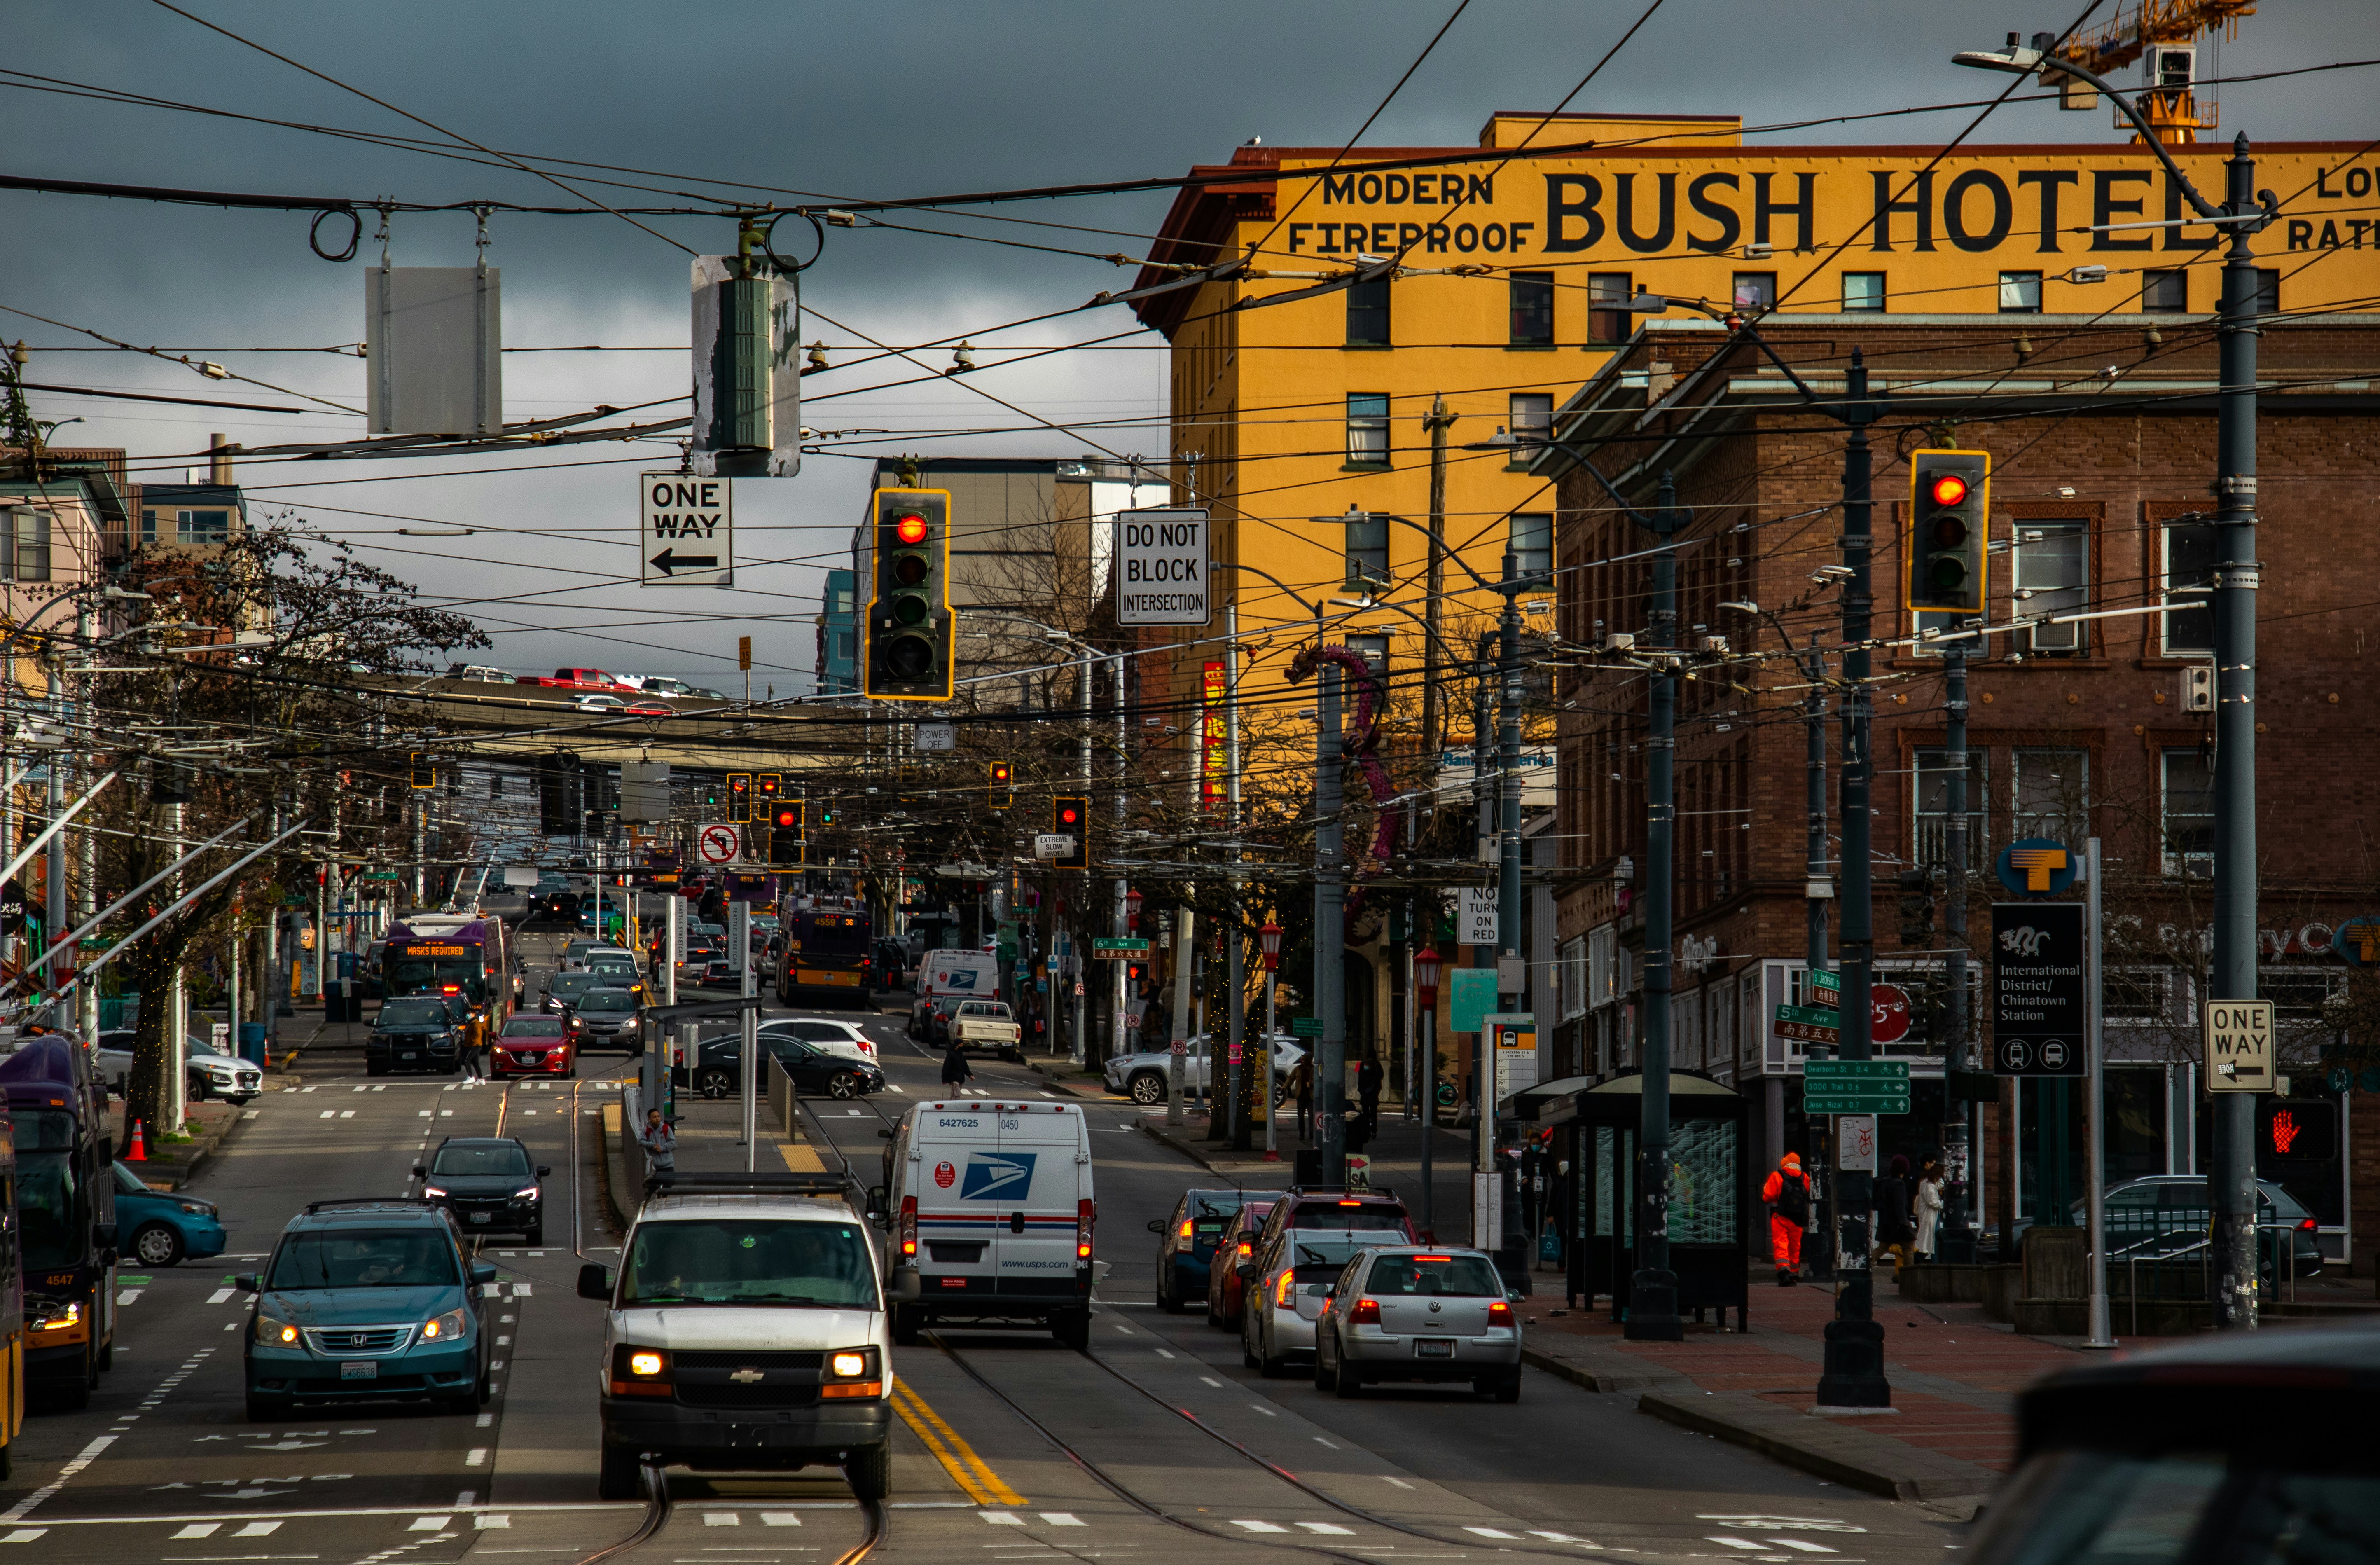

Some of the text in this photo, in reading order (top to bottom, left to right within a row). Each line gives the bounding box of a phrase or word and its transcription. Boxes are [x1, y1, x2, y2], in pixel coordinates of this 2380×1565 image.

[2318, 167, 2380, 198] LO
[1323, 173, 1493, 205] MODERN
[1542, 169, 2219, 253] BUSH HOTEL
[1289, 222, 1534, 253] FIREPROOF
[652, 482, 719, 508] ONE
[653, 514, 722, 538] WAY
[1127, 524, 1199, 547] DO NOT
[1128, 559, 1198, 582] BLOCK
[1124, 594, 1203, 611] INTERSECTION
[919, 730, 949, 739] POWER
[927, 740, 942, 749] OFF
[1473, 887, 1495, 900] NO
[1469, 903, 1499, 913] TURN
[814, 917, 836, 926] 4559
[1476, 917, 1491, 926] ON
[1473, 930, 1495, 939] RED
[407, 946, 464, 956] MASKS REQUIRED
[1100, 950, 1141, 958] 南第六大道
[2000, 964, 2080, 975] International
[1814, 974, 1817, 983] S
[1820, 972, 1835, 987] Jackson
[2001, 979, 2053, 992] District/
[2001, 994, 2066, 1006] Chinatown
[1781, 1006, 1828, 1022] 5th Ave
[2001, 1009, 2045, 1020] Station
[2214, 1009, 2265, 1029] ONE
[2215, 1034, 2267, 1054] WAY
[939, 1119, 1019, 1130] 6427625 0450
[1002, 1260, 1068, 1269] www.usps.com
[46, 1275, 74, 1286] 4547
[342, 1368, 375, 1378] BWS6638
